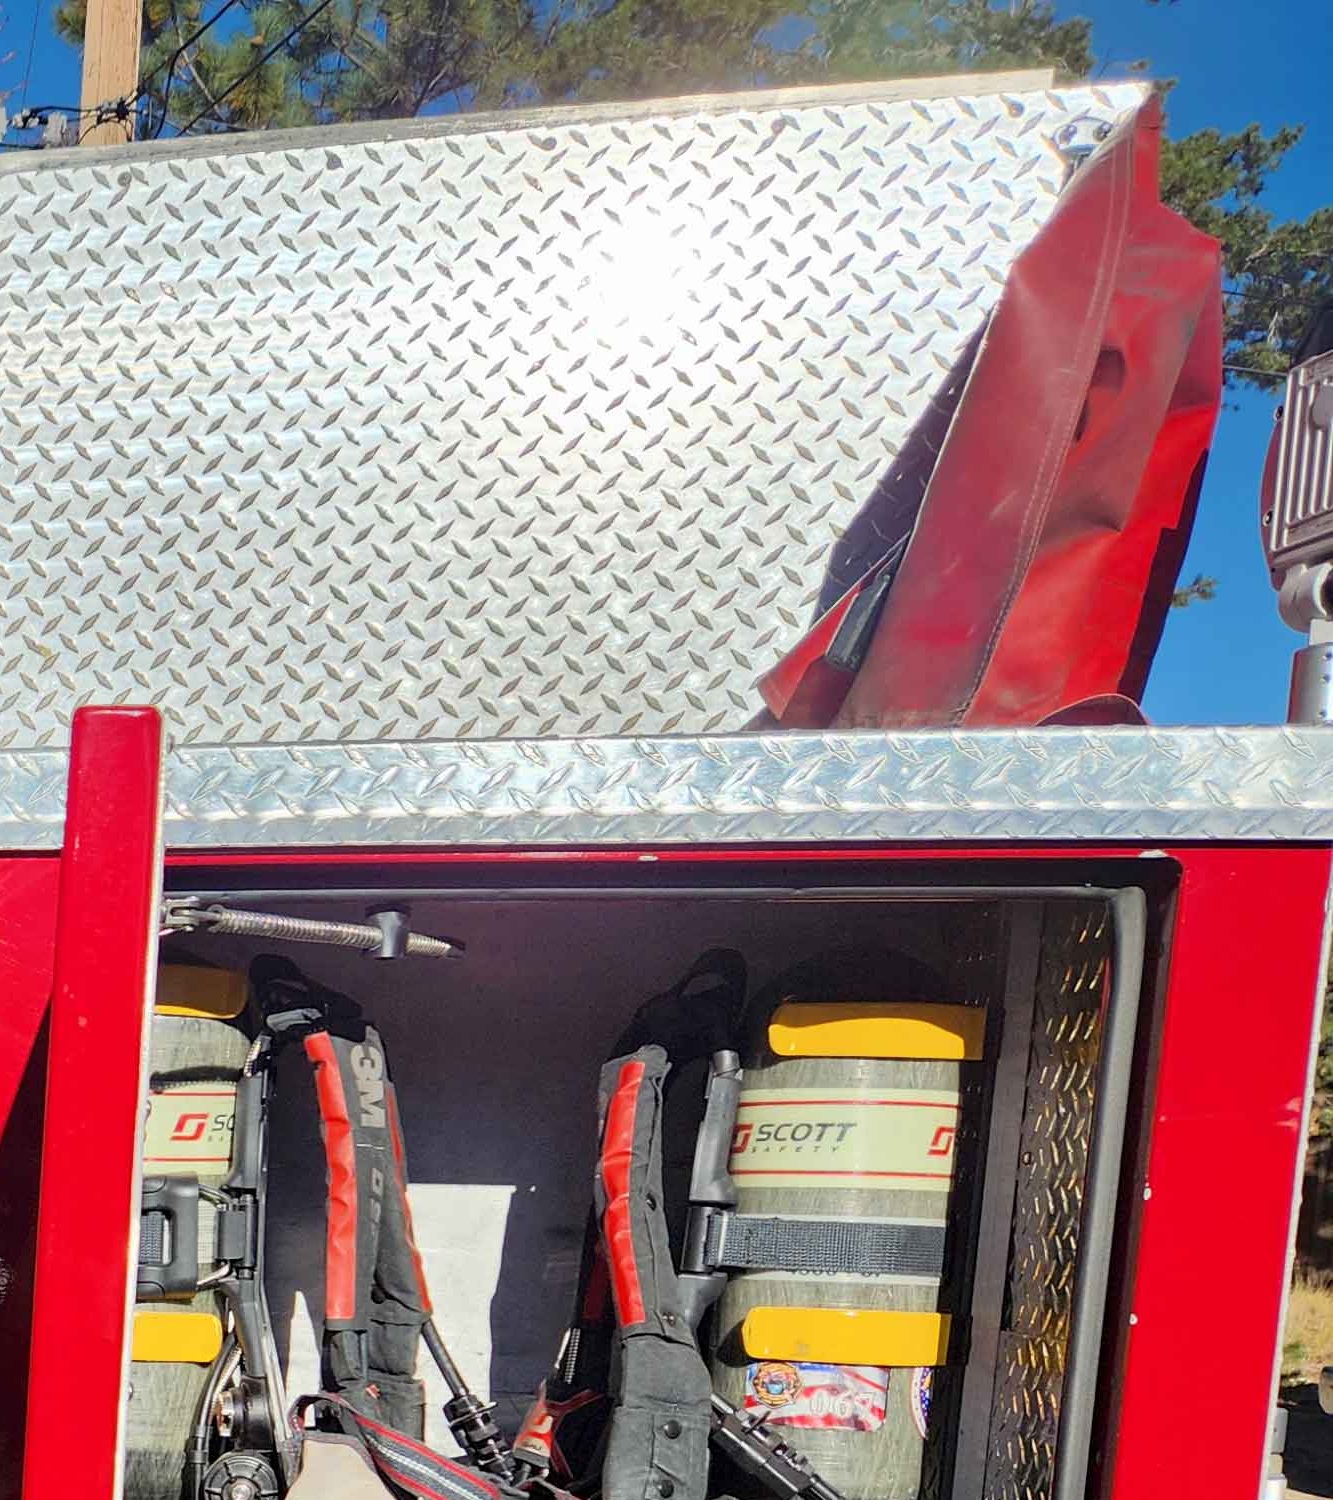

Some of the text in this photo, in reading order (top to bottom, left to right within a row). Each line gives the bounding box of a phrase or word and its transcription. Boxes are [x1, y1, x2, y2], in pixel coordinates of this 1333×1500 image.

[350, 1045, 386, 1128] 3M
[756, 1122, 857, 1142] SCOTT
[752, 1145, 841, 1153] SAFETY
